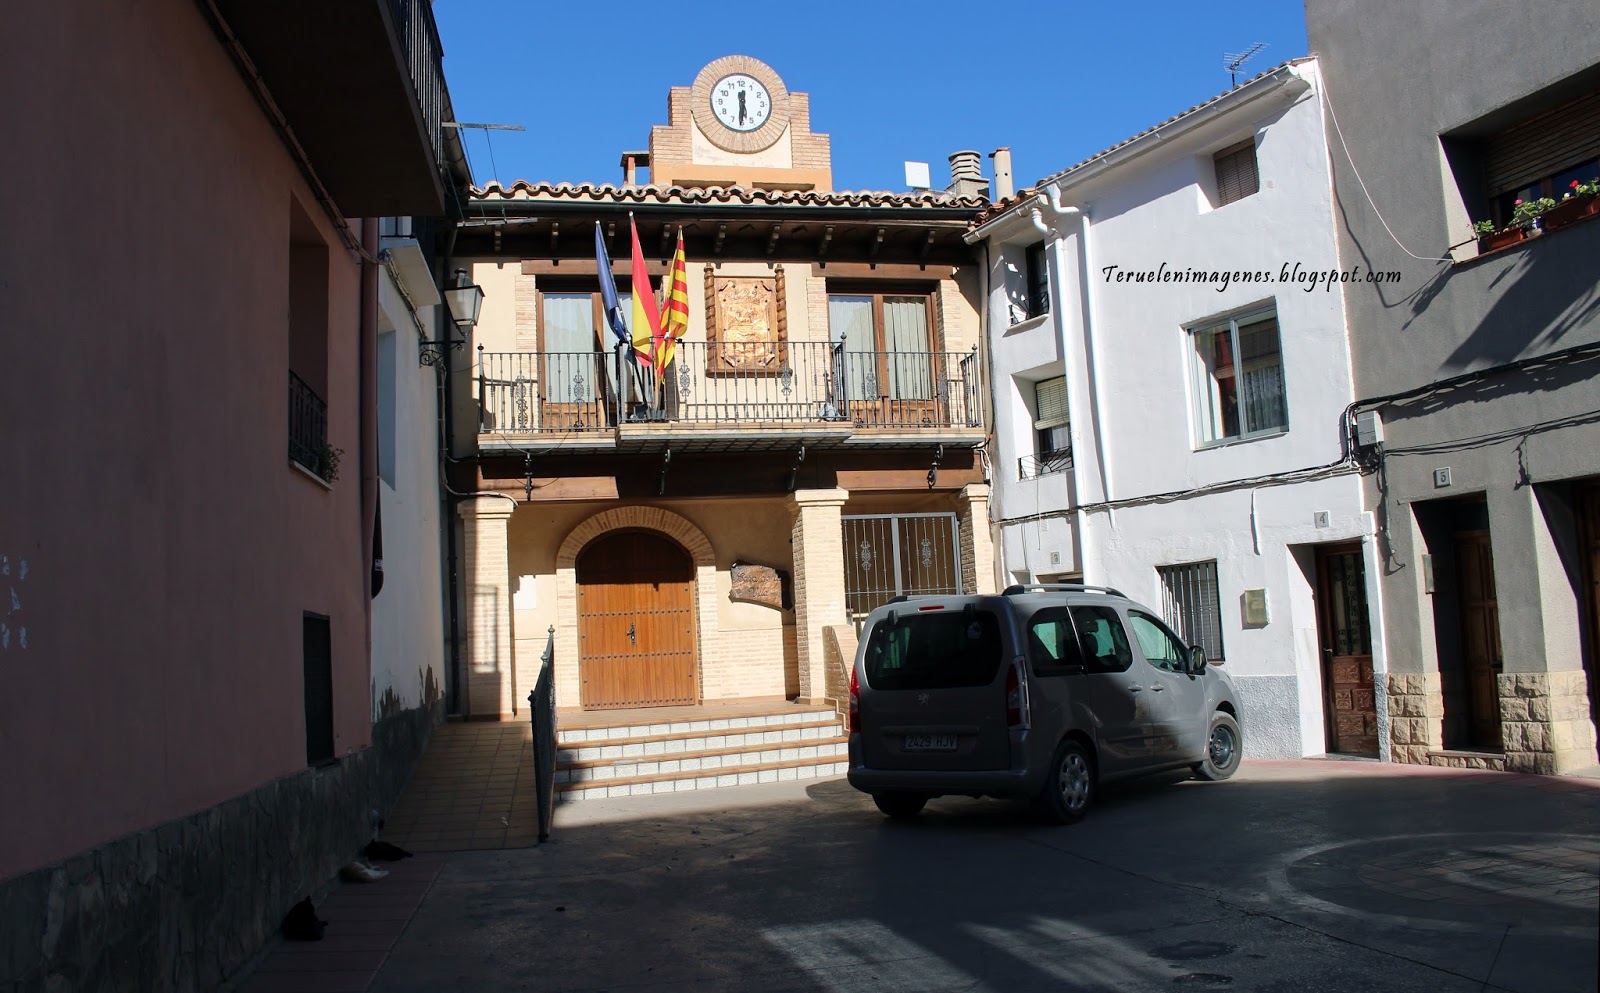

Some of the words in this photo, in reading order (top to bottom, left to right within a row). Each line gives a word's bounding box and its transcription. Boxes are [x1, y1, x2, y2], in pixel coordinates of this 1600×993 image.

[727, 82, 735, 90] 11
[736, 80, 746, 88] 12
[720, 89, 729, 97] 10
[756, 91, 762, 99] 2
[718, 98, 723, 106] 9
[759, 100, 765, 108] 3
[721, 107, 727, 115] 8
[730, 115, 735, 123] 7
[749, 116, 754, 124] 5
[1440, 470, 1447, 483] 5
[1319, 512, 1325, 524] 4
[1053, 553, 1059, 563] 3
[907, 735, 932, 747] 2429
[936, 735, 957, 747] HJV
